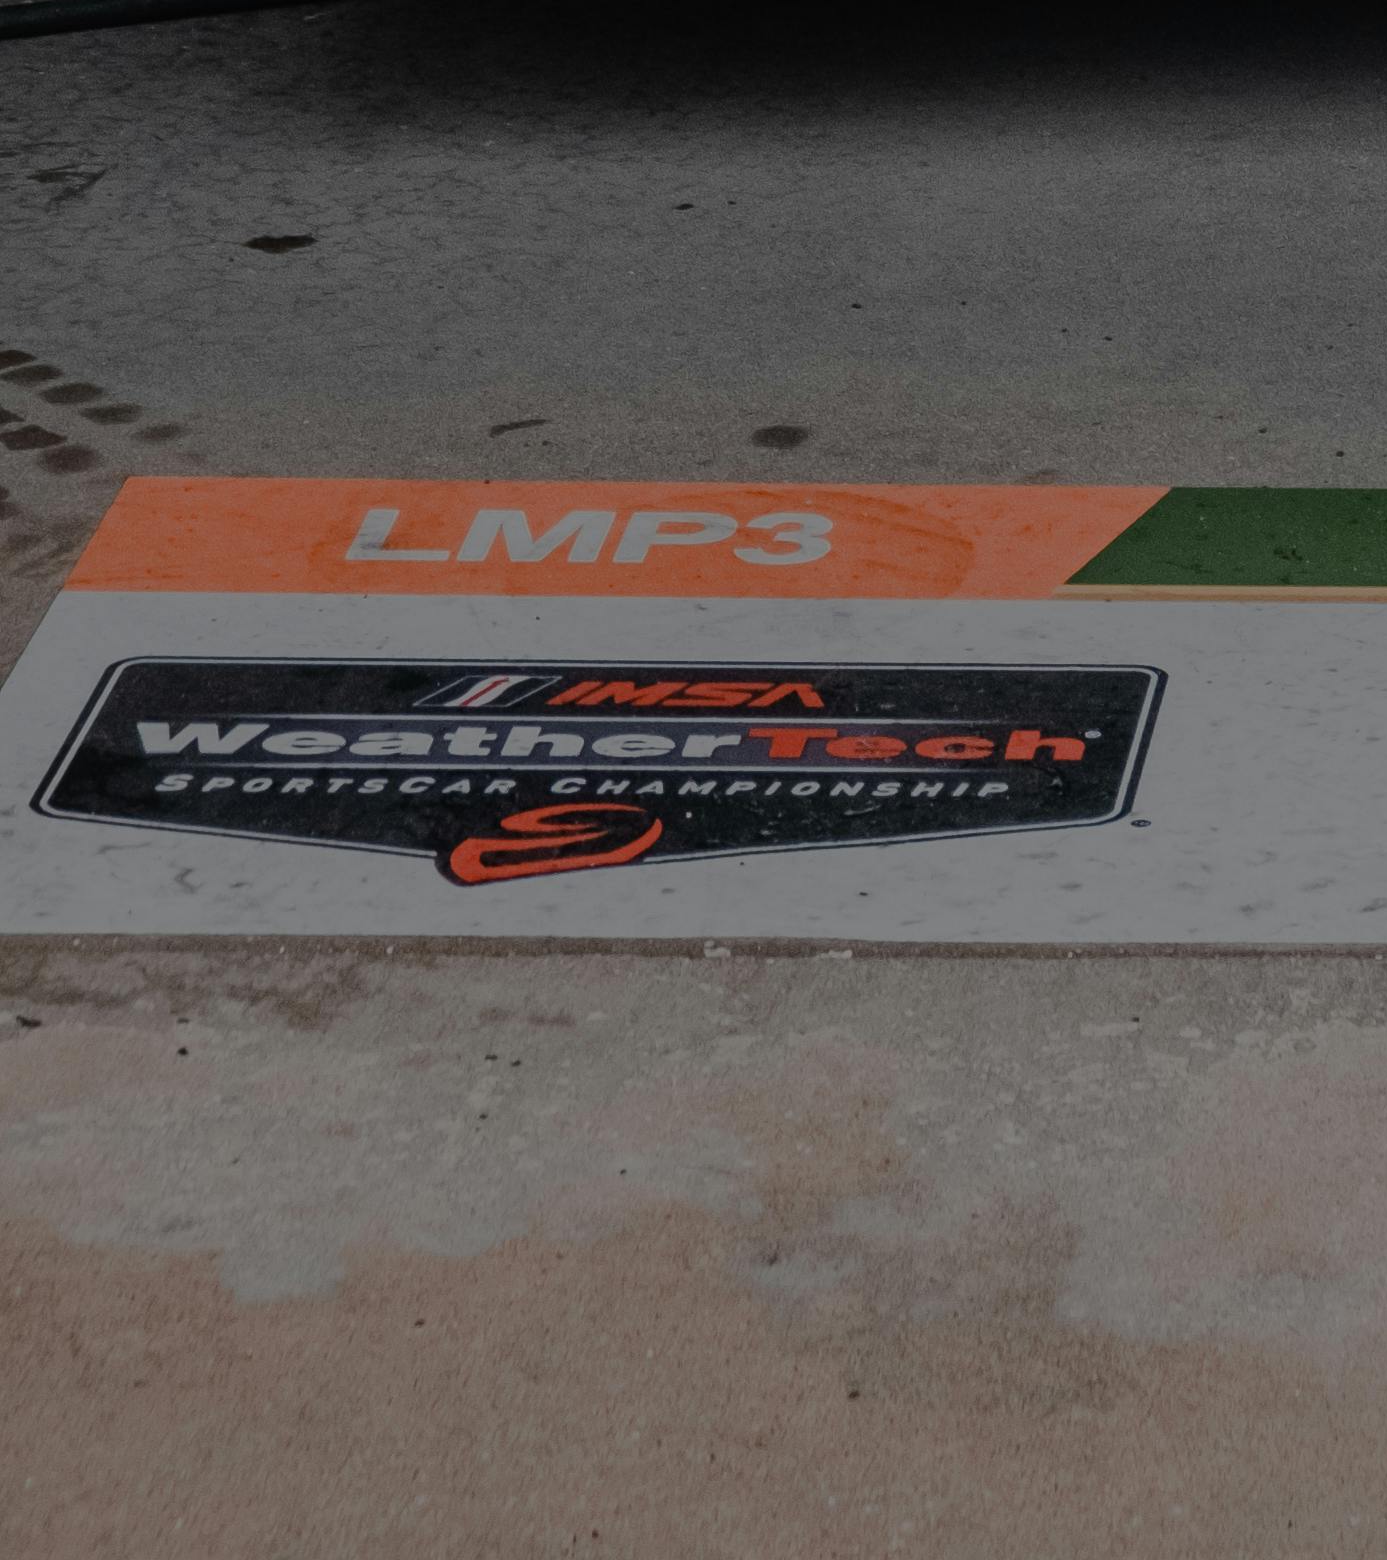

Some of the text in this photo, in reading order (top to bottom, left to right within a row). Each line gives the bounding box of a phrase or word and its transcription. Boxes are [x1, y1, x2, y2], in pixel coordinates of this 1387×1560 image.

[345, 507, 834, 565] LMP3
[544, 680, 826, 709] IMSA
[135, 721, 1087, 762] WeatherTech
[154, 772, 1010, 798] SPORTSCAR CHAMPIONSHIP
